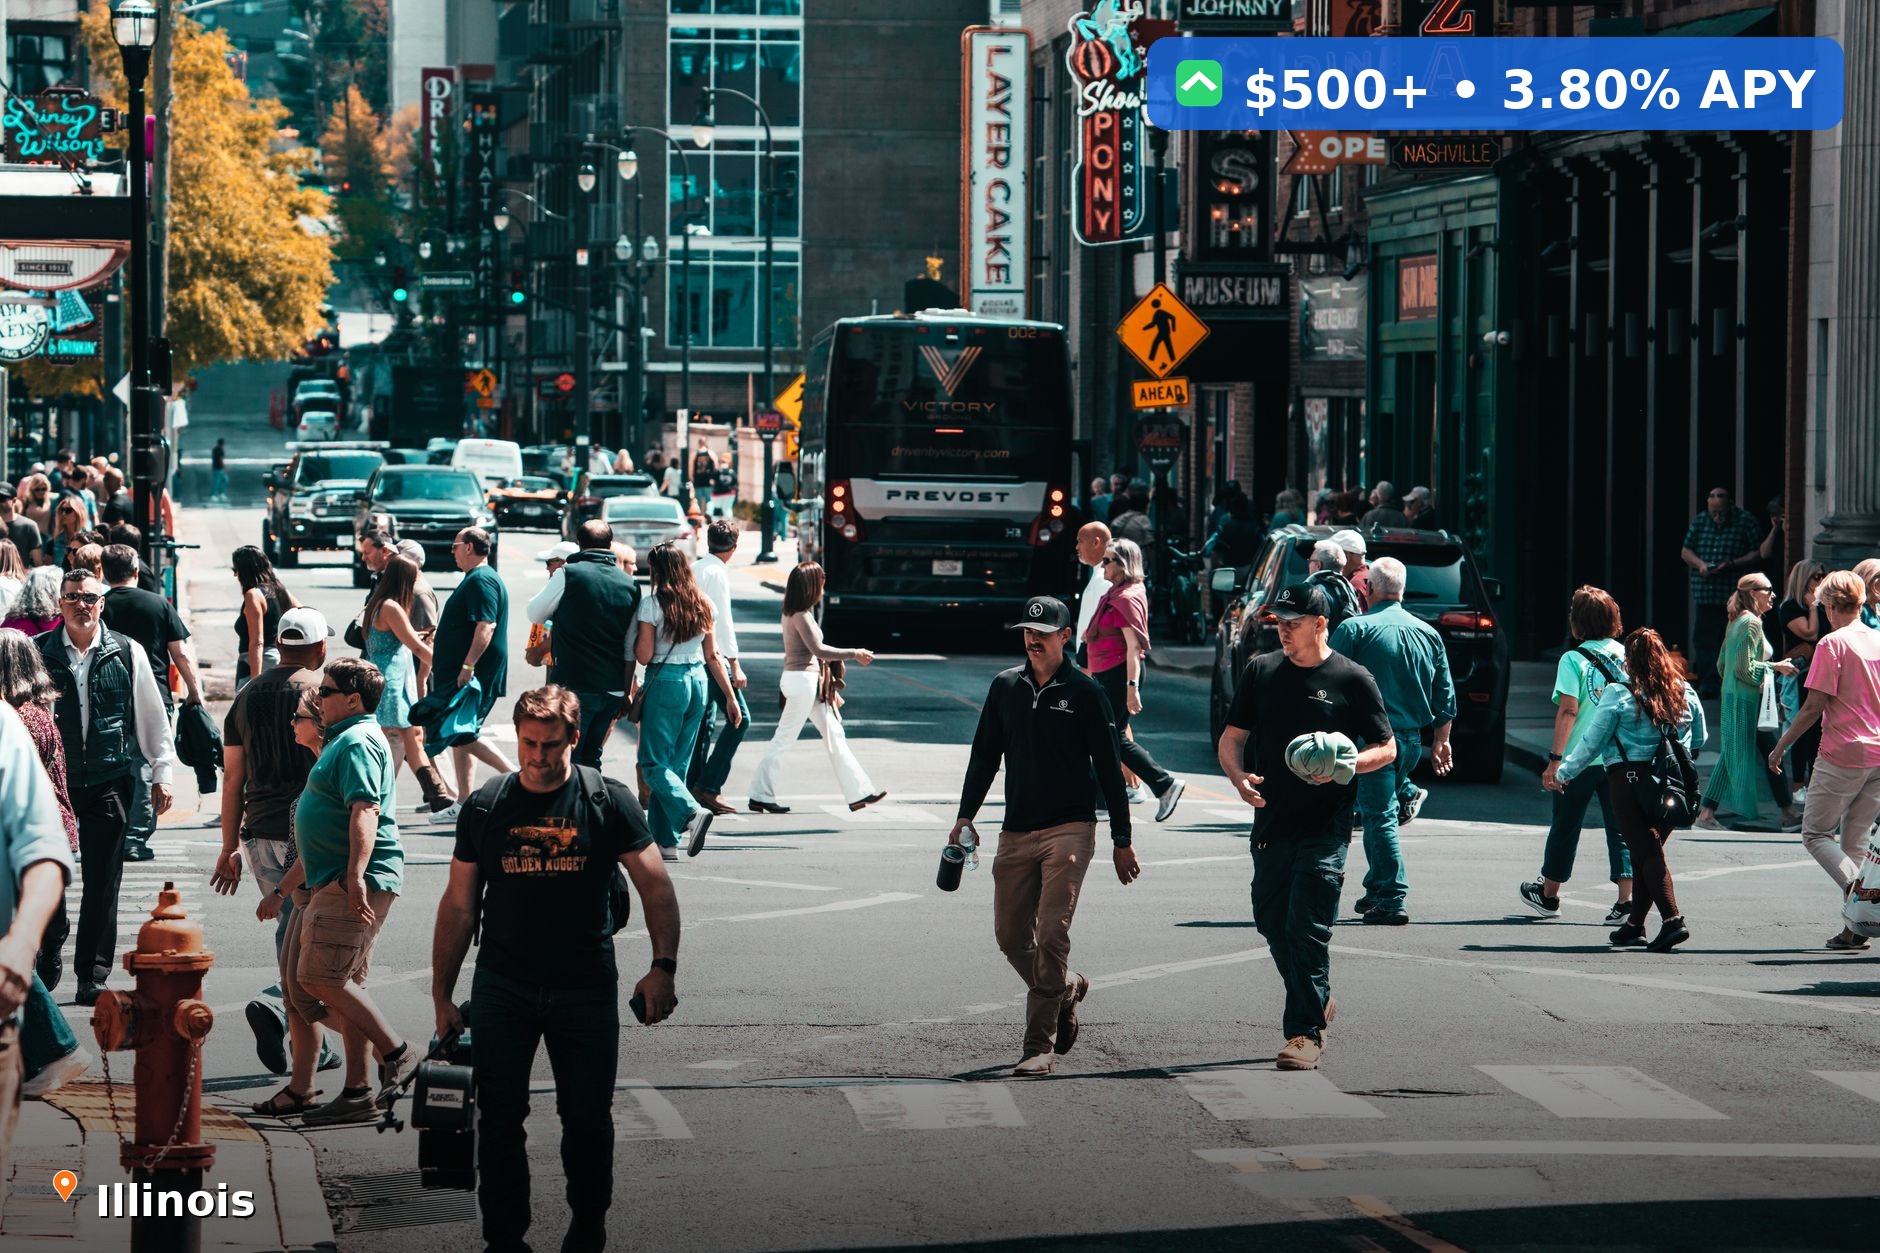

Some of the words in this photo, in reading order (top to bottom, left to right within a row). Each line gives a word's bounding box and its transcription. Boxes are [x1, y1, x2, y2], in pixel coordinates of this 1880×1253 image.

[1186, 0, 1283, 17] JOHNNY
[984, 45, 1013, 171] LAYER
[15, 130, 105, 160] Wilson's
[1319, 137, 1386, 159] OPE
[1404, 142, 1491, 164] NASHVILLE
[479, 132, 492, 211] HYATT
[1091, 112, 1113, 235] PONY
[983, 181, 1013, 286] CAKE
[21, 262, 47, 272] SINCE
[1184, 276, 1281, 307] MUSEUM
[1008, 326, 1037, 339] 002
[1139, 384, 1185, 402] AHEAD
[904, 400, 996, 413] VICTORY
[886, 489, 1010, 503] PREVOST
[501, 857, 541, 873] GOLDEN
[545, 856, 587, 871] NUGGET
